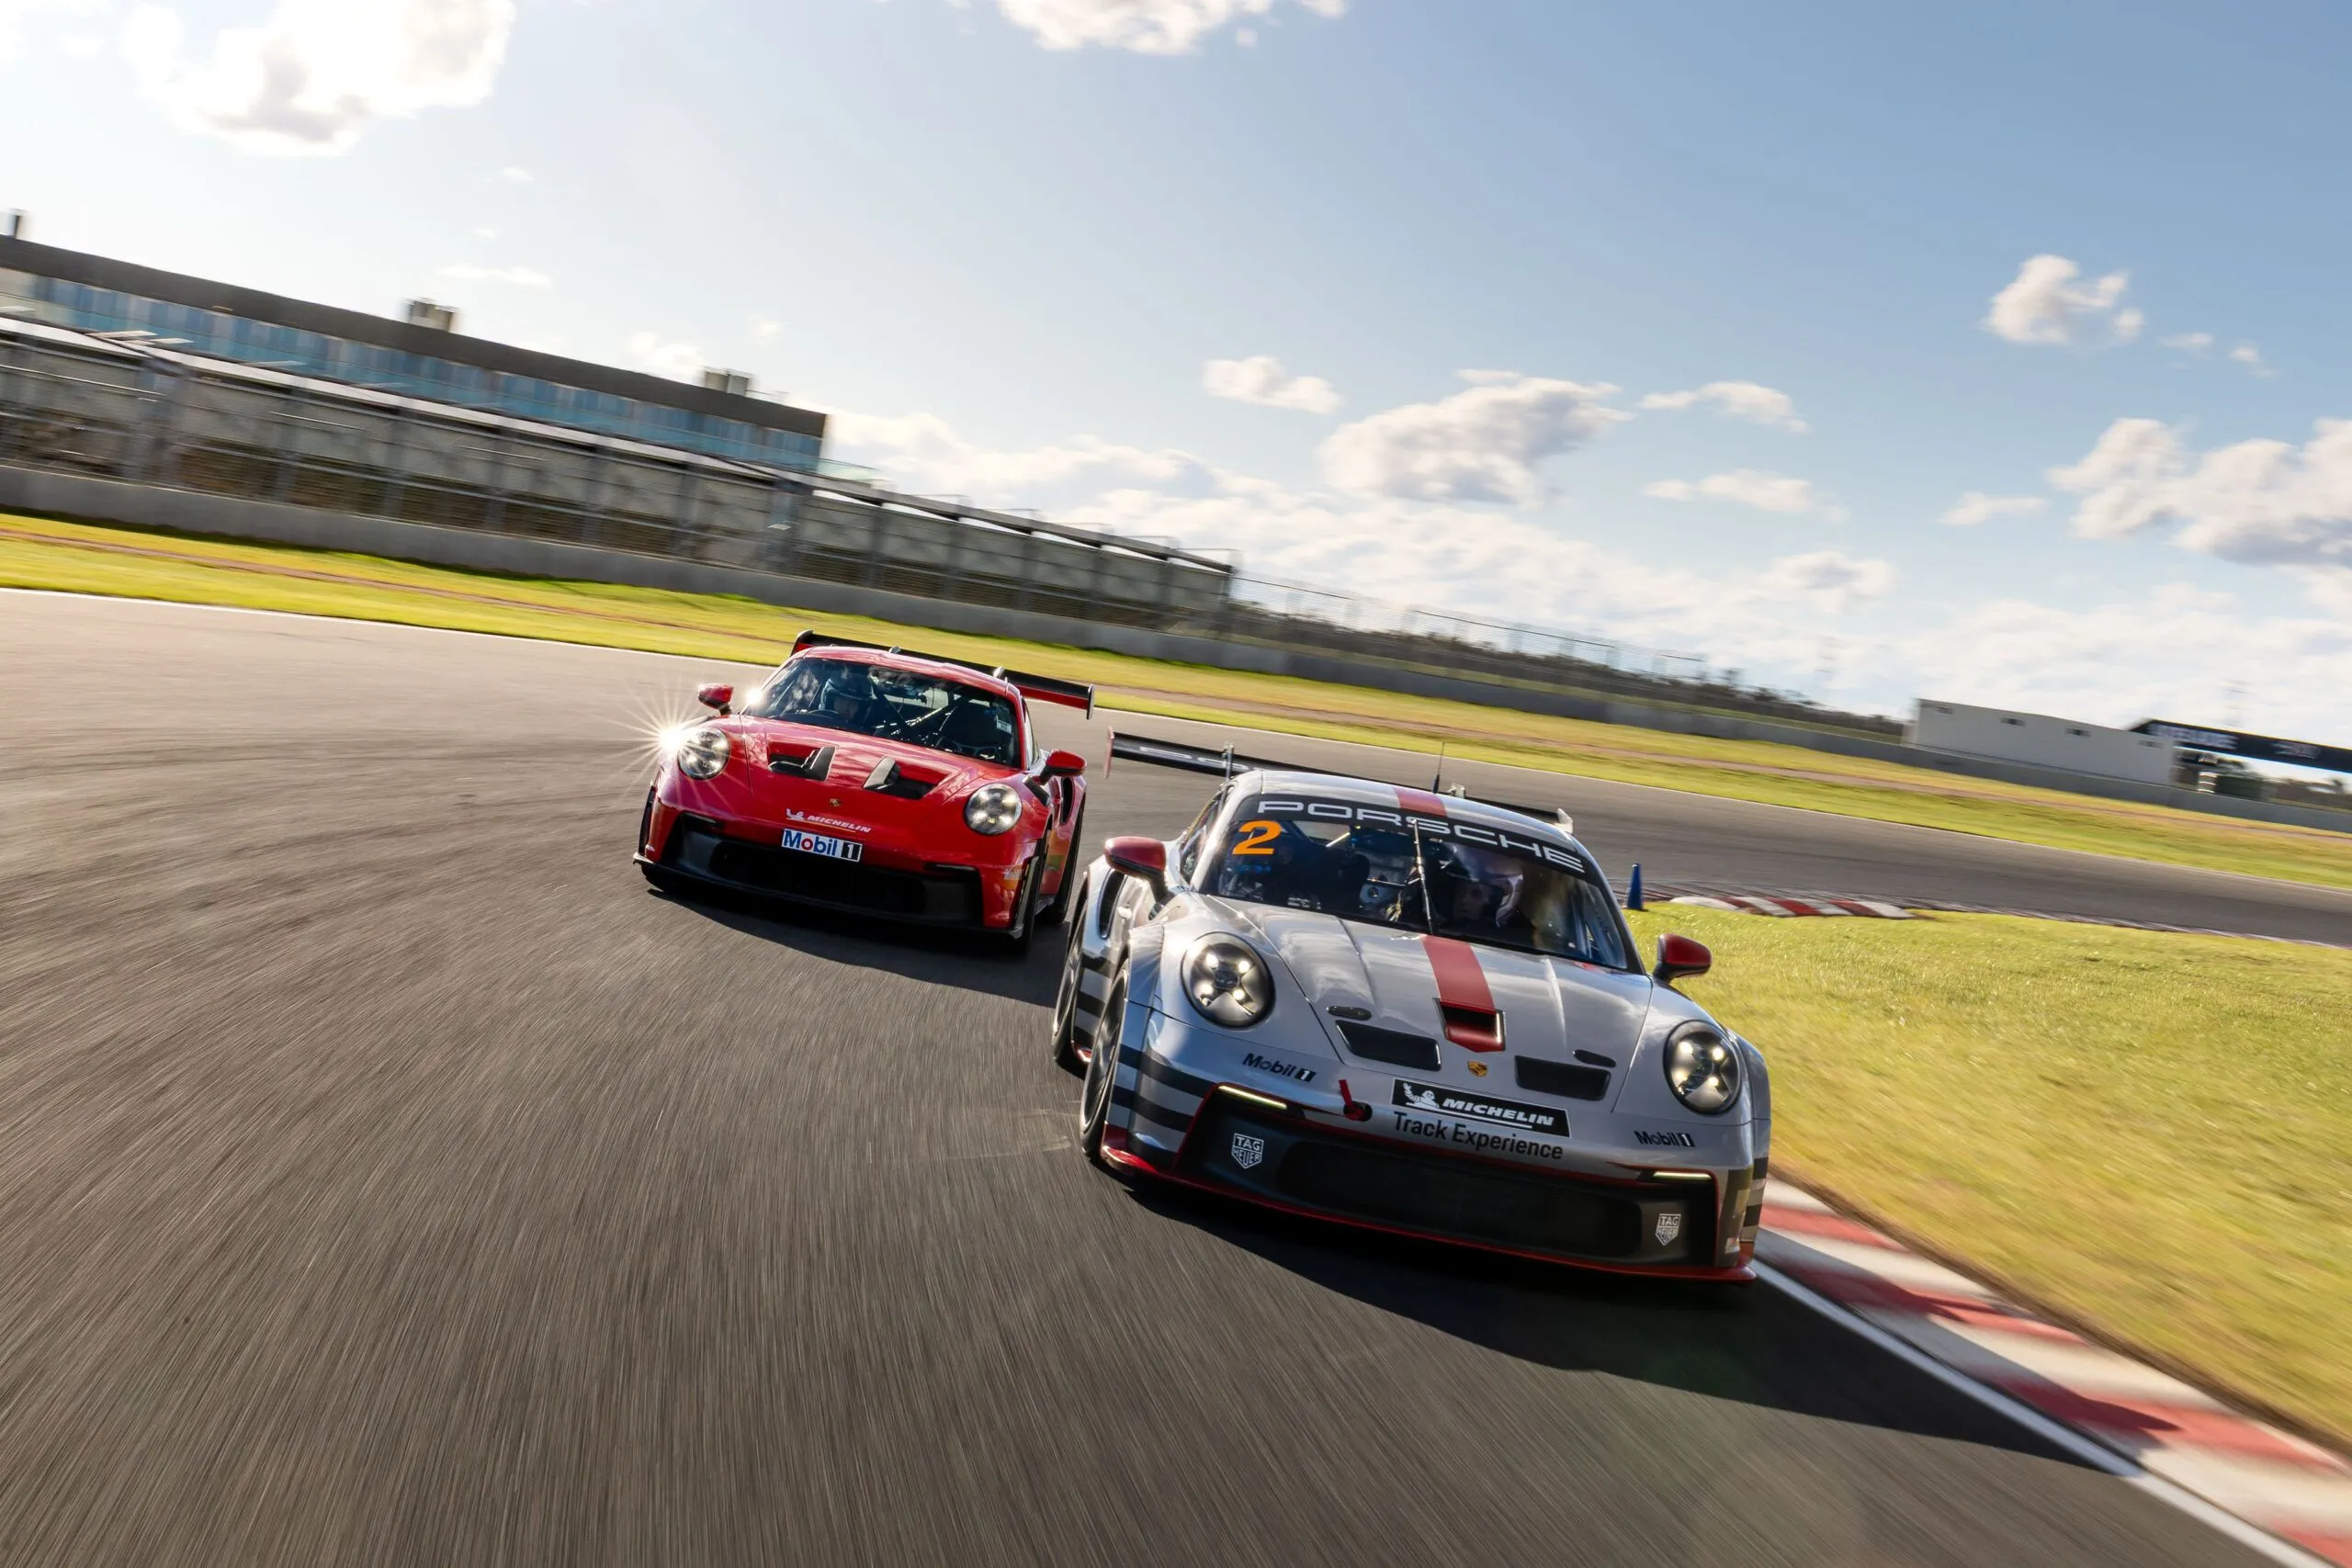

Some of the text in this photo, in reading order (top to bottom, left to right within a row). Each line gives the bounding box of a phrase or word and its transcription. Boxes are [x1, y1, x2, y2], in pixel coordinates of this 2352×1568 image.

[807, 815, 872, 832] MICHELIN
[784, 829, 837, 856] Mobil
[1232, 820, 1283, 855] 2
[1258, 801, 1585, 873] PORSCHE
[1241, 1053, 1297, 1077] Mobil
[1442, 1098, 1555, 1126] MICHELIN
[1236, 1135, 1261, 1151] TAG
[1394, 1111, 1563, 1159] Track Experience
[1634, 1131, 1680, 1146] Mobil
[1233, 1148, 1260, 1166] HEUER
[1660, 1215, 1679, 1226] TAG
